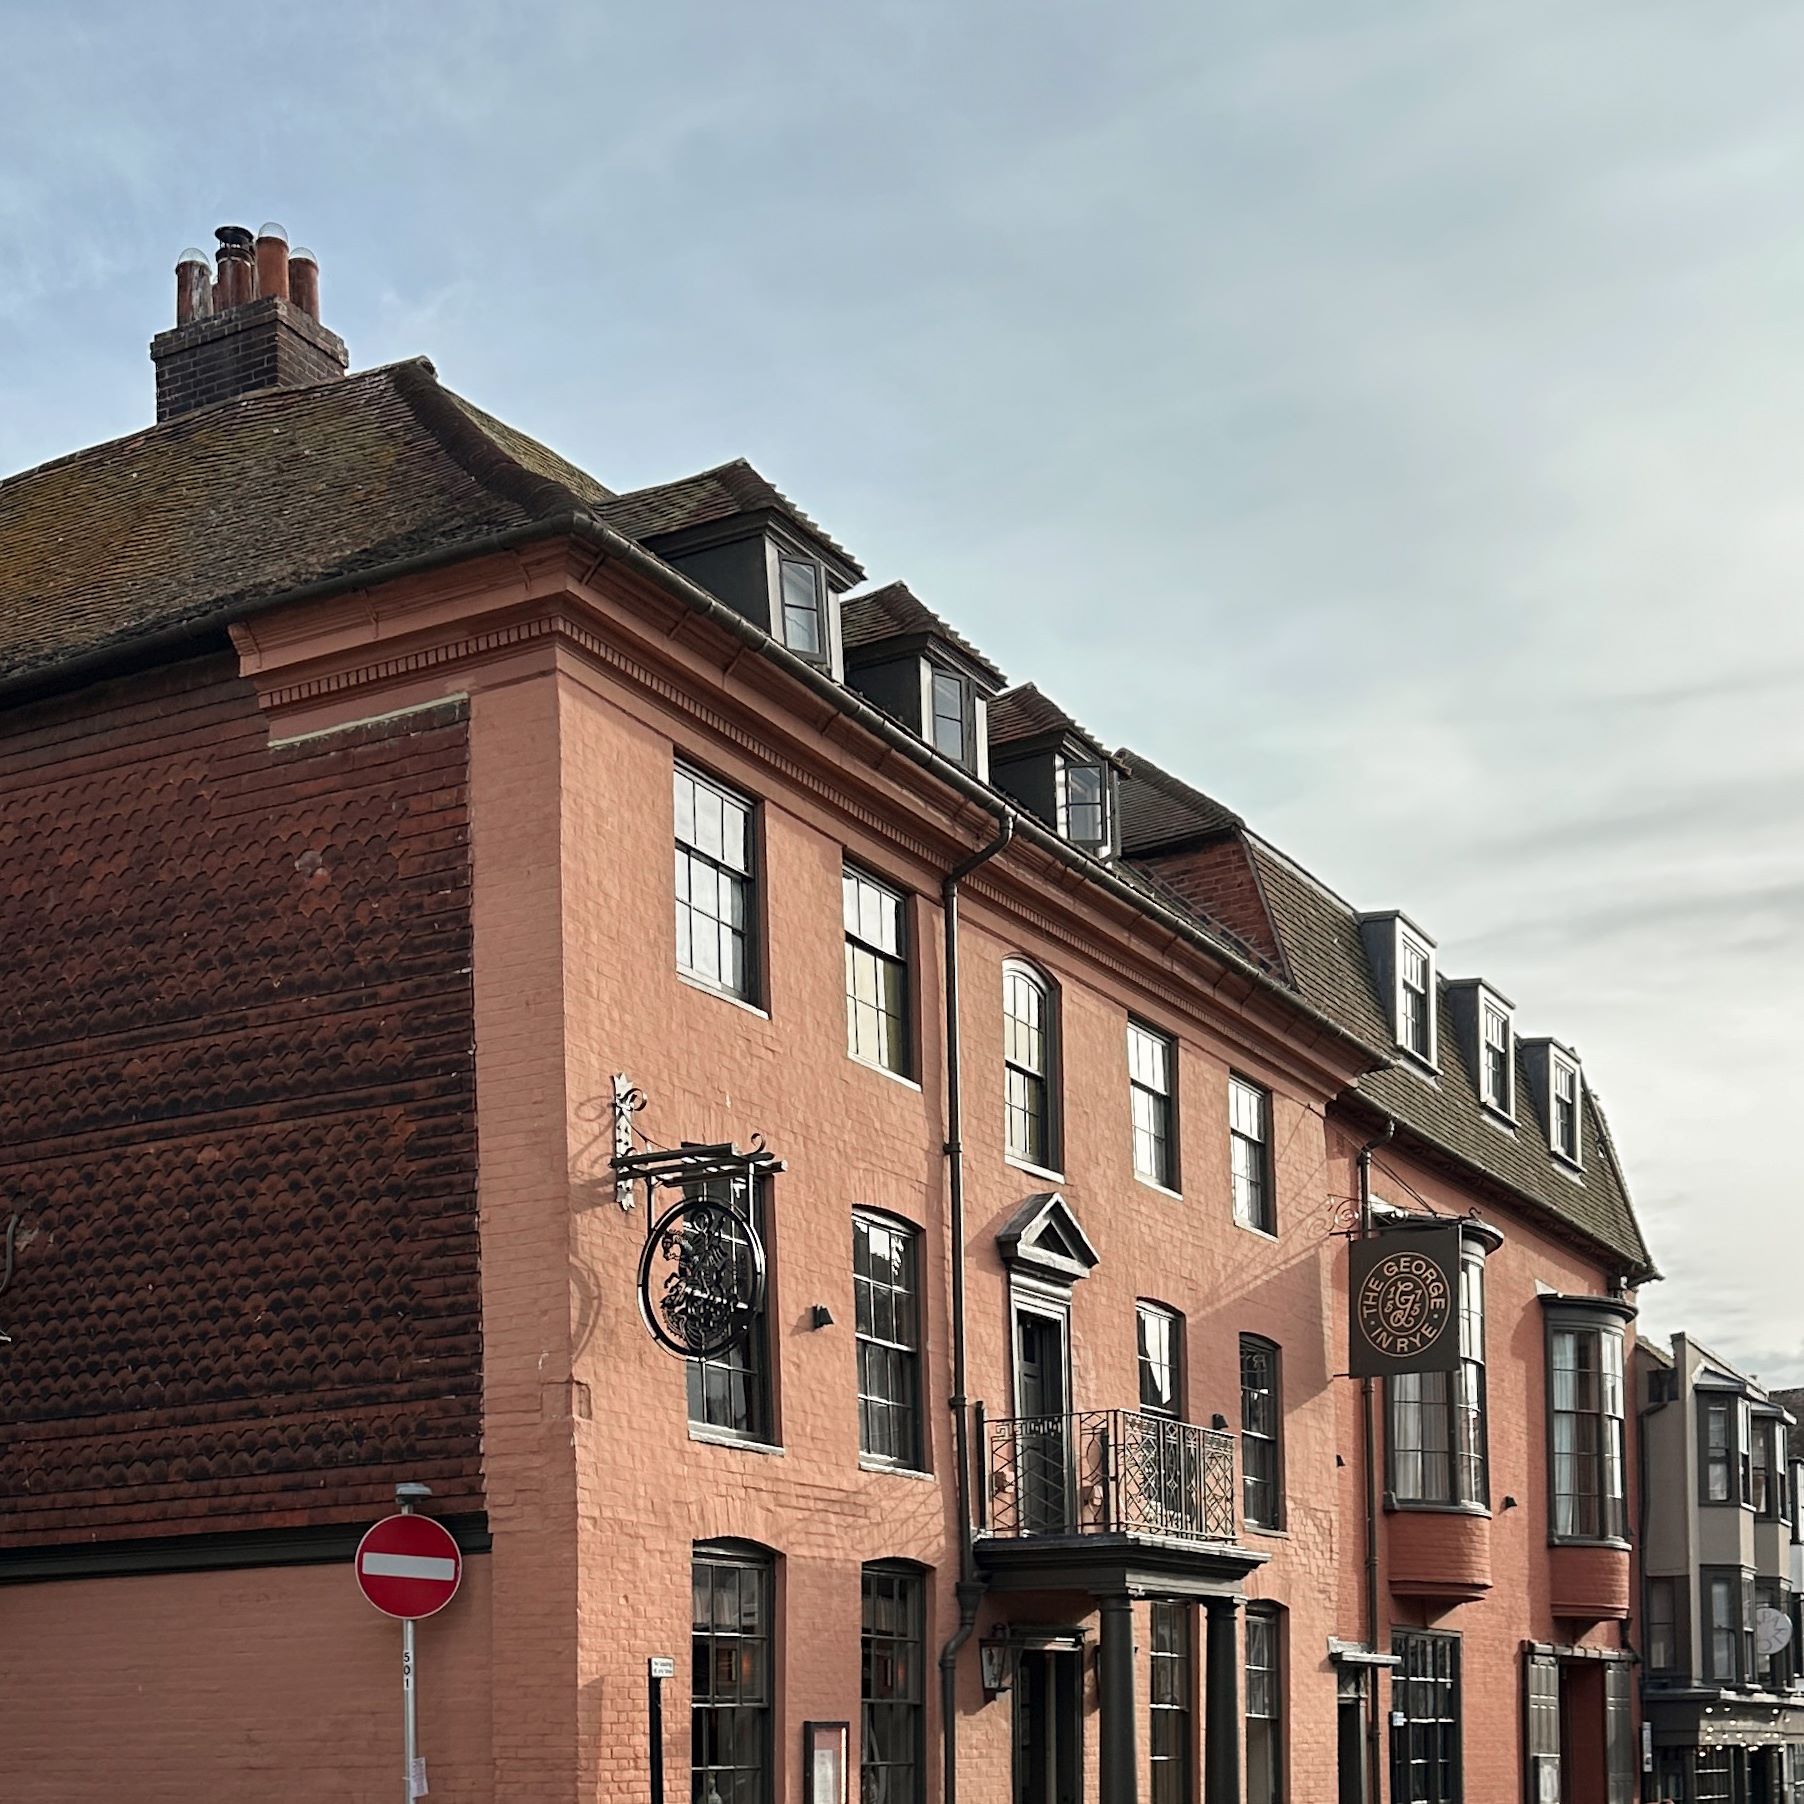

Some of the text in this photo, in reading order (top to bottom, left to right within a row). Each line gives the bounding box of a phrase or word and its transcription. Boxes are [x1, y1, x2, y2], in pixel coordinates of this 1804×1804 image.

[1363, 1257, 1446, 1319] THE GEORGE
[1370, 1322, 1438, 1352] IN RYE
